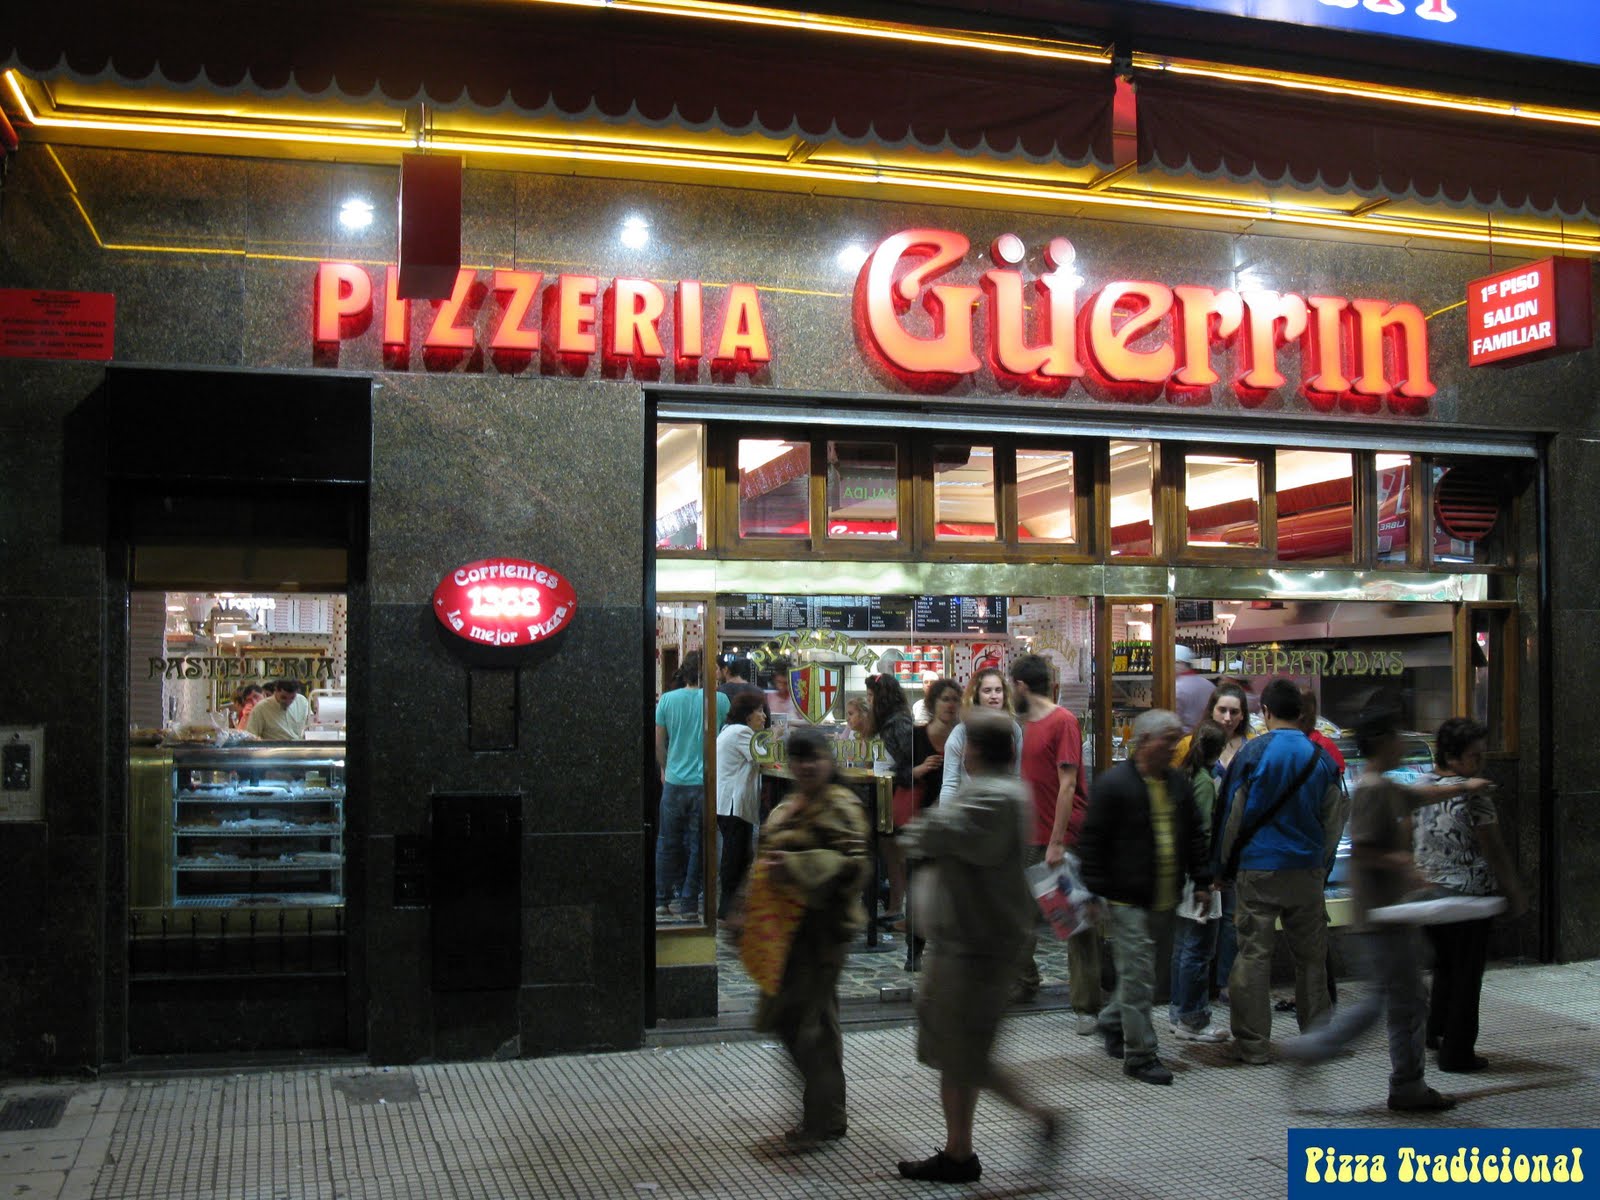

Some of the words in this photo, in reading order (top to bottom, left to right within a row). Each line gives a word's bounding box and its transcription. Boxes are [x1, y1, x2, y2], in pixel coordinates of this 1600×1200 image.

[1500, 271, 1539, 298] PISO
[313, 262, 772, 364] PIZZERIA
[1483, 298, 1538, 329] SALON
[1472, 321, 1551, 356] FAMILIAR
[454, 562, 559, 589] Corrientes
[469, 625, 518, 646] mejor
[527, 606, 567, 641] Pizza
[750, 627, 880, 673] PIZZERIA
[1222, 650, 1405, 676] EMPANADAS
[147, 656, 335, 680] PASTELERIA
